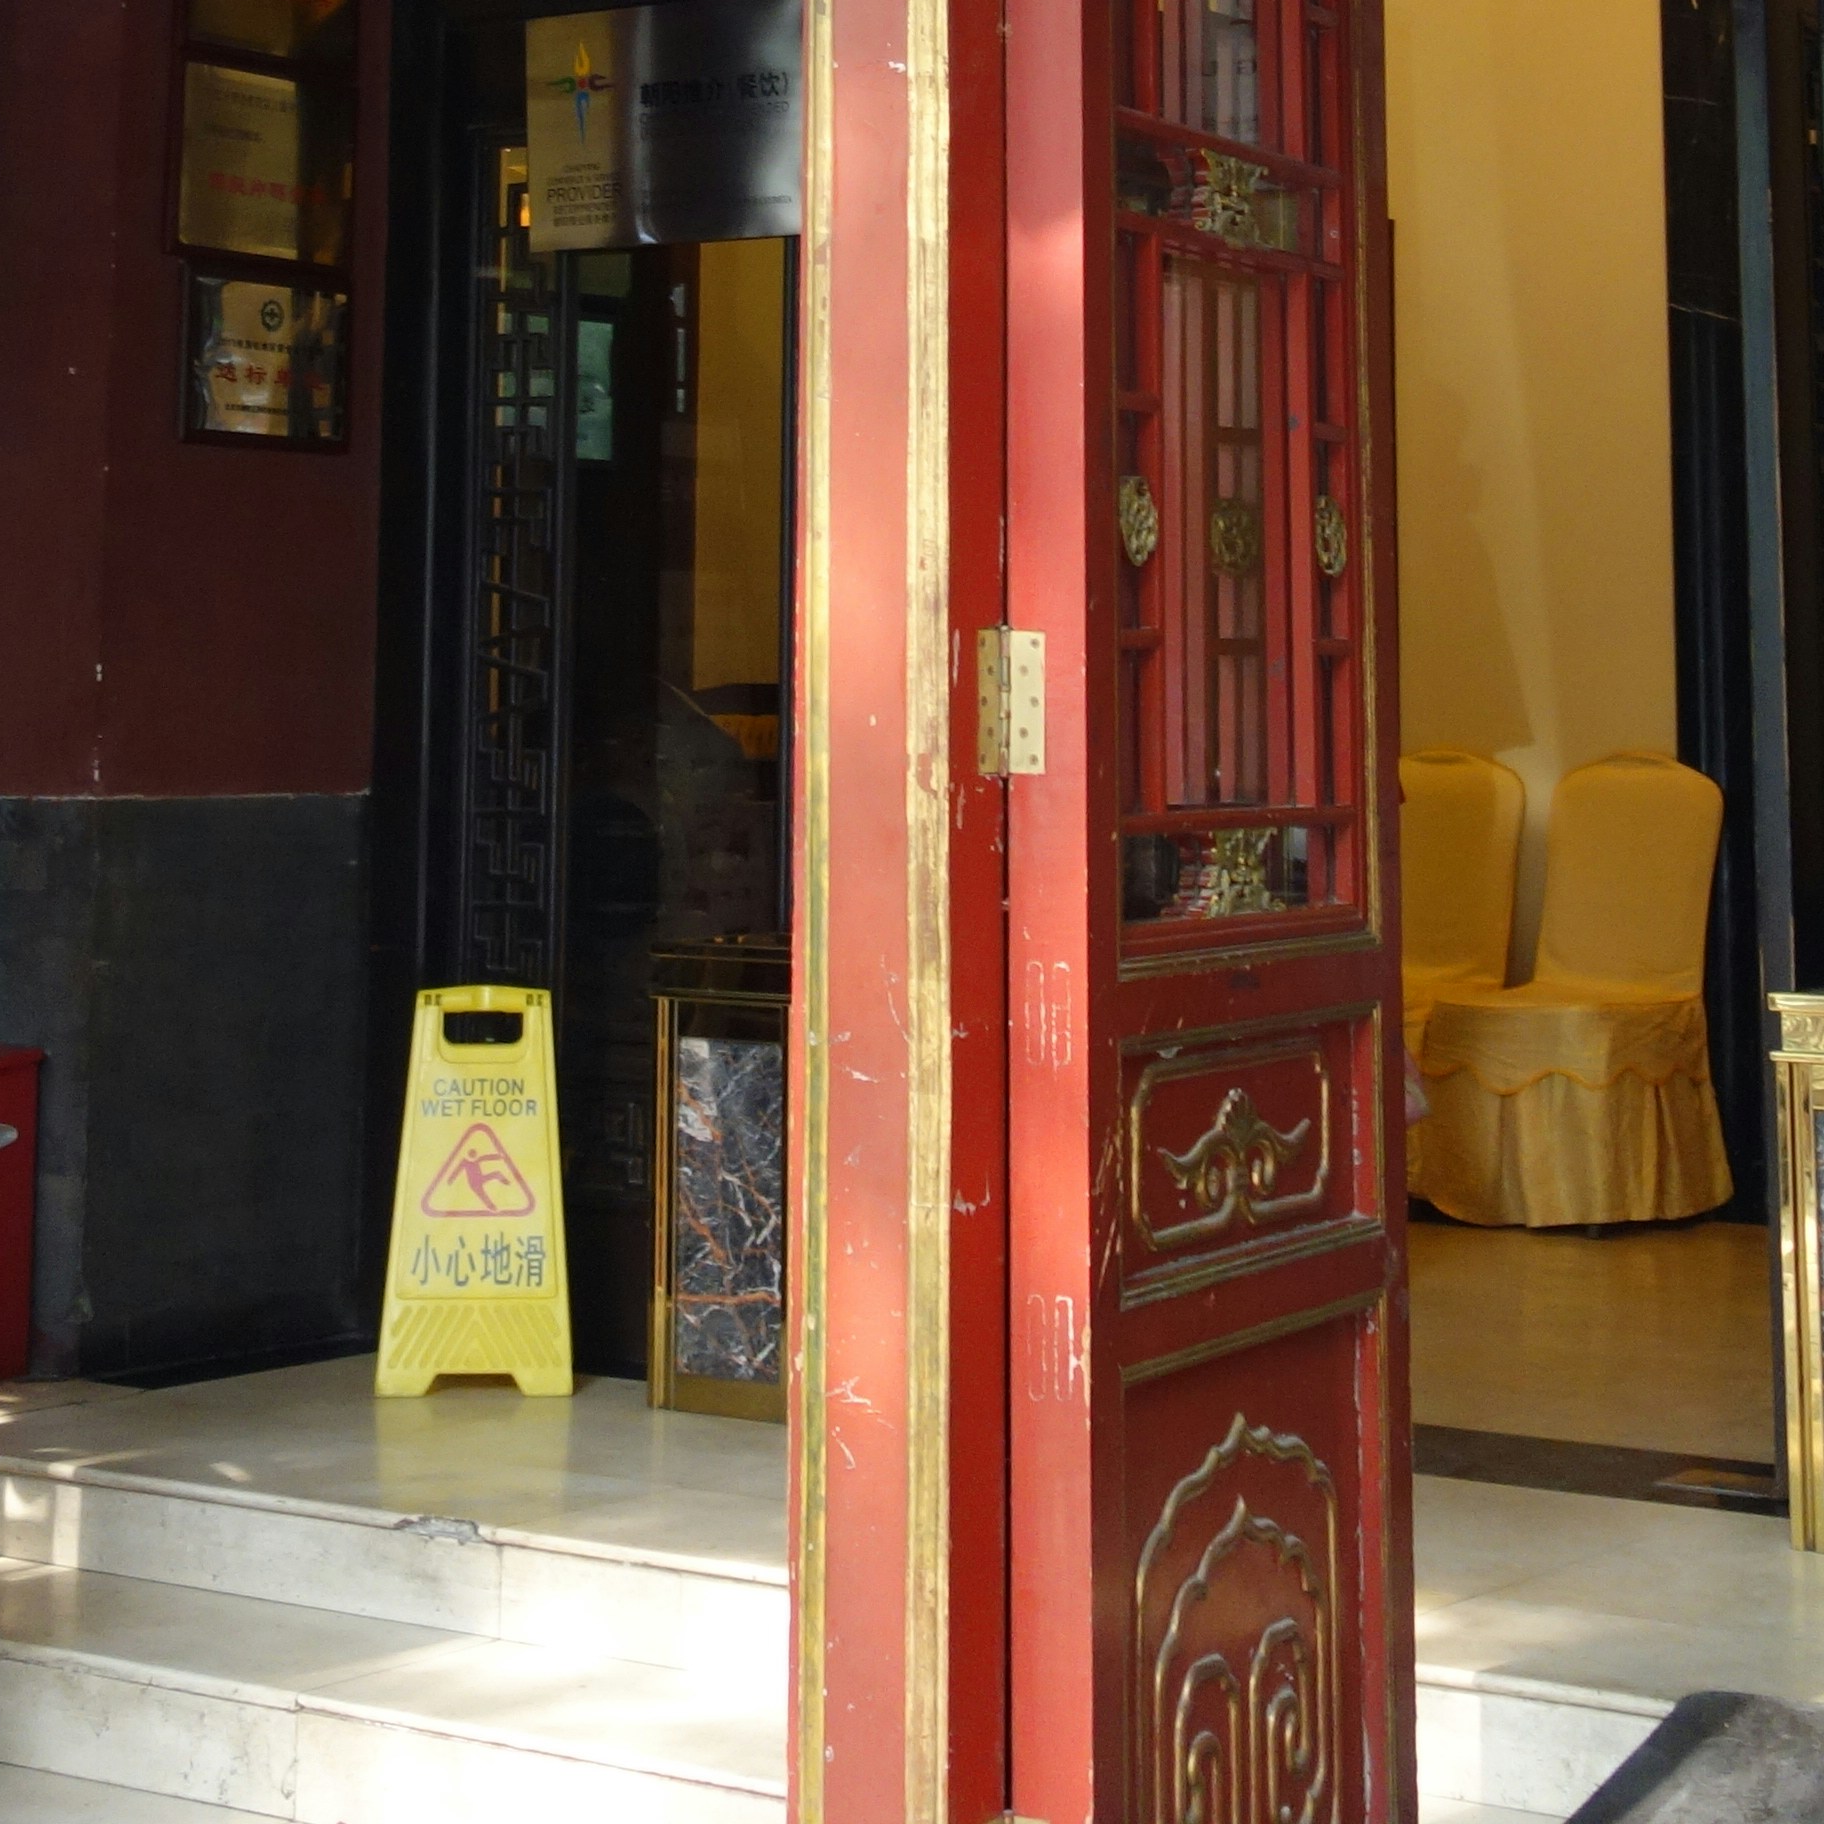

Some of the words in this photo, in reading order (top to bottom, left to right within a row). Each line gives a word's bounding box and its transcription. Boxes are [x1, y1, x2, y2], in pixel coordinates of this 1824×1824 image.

[433, 1078, 525, 1097] CAUTION
[420, 1099, 466, 1117] WET
[470, 1099, 537, 1117] FLOOR
[410, 1232, 546, 1288] 小心地滑
